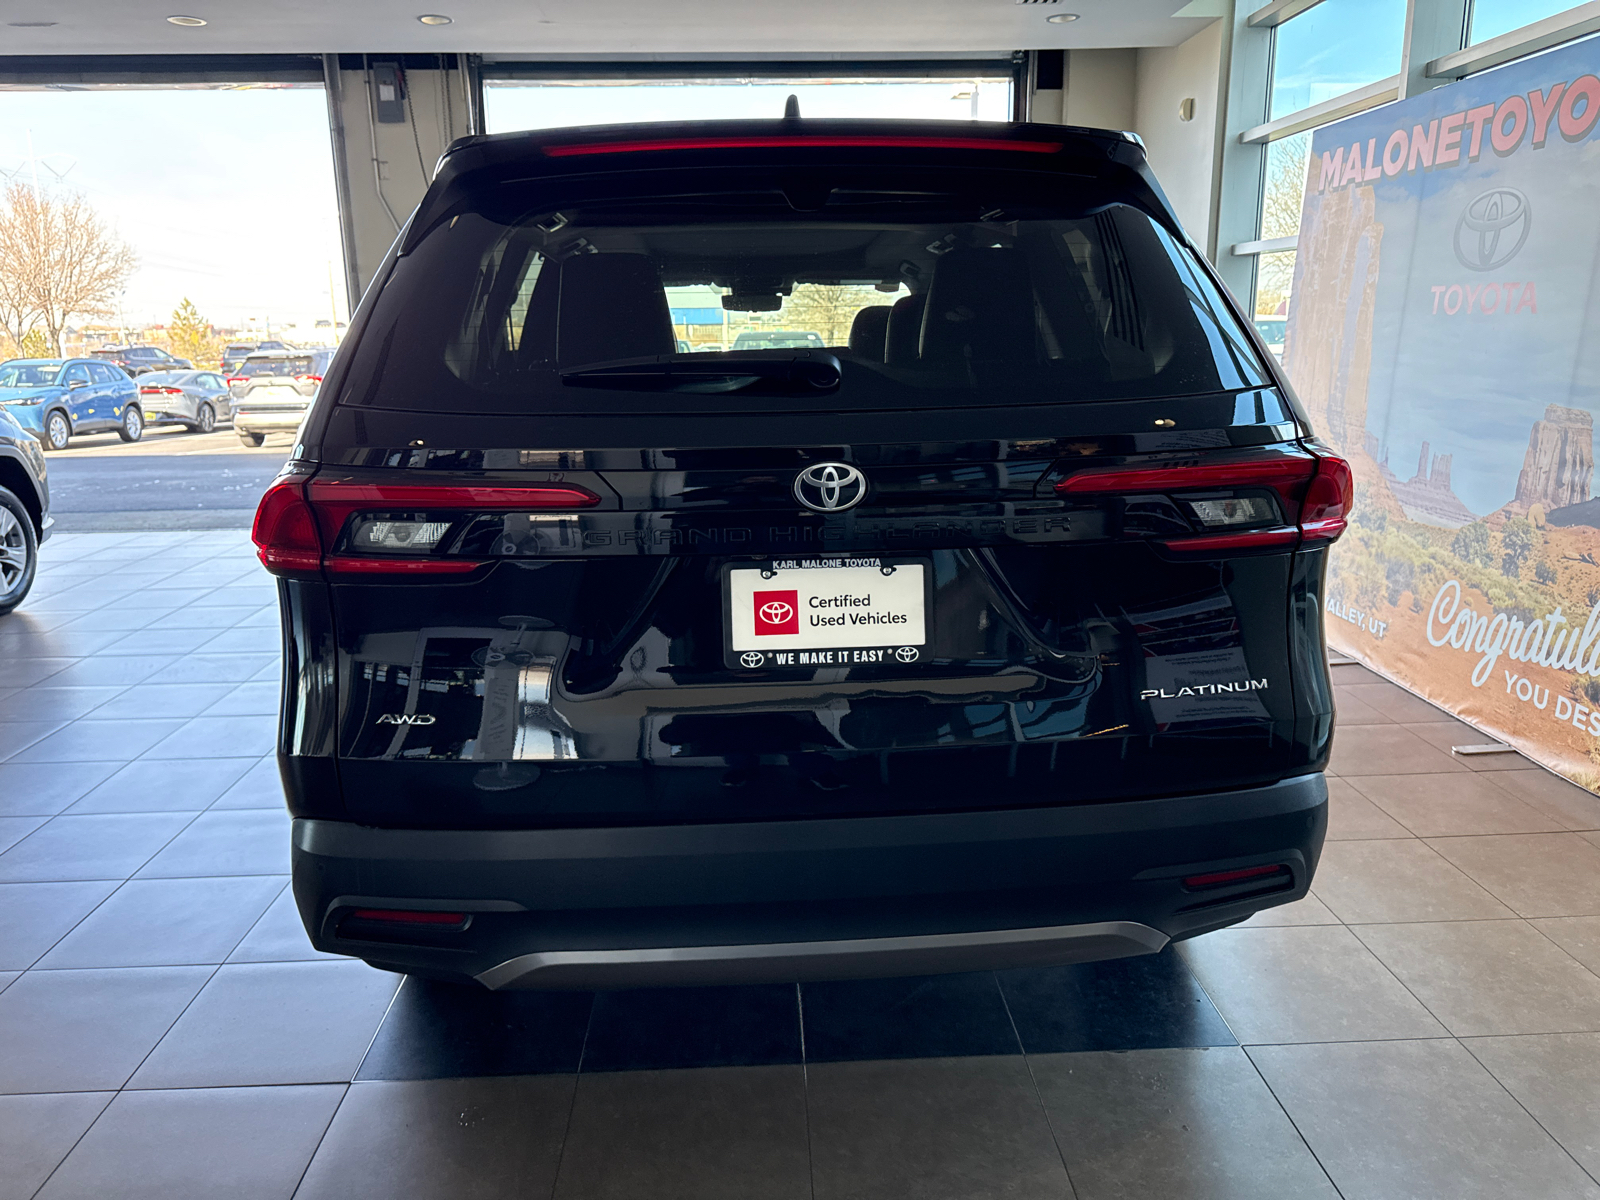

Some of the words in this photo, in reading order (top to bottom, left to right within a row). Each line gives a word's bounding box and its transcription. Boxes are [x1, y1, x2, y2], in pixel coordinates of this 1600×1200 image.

[1430, 281, 1538, 315] TOYOTA
[583, 527, 751, 546] GRAND
[772, 560, 799, 570] KARL
[801, 559, 842, 569] MALONE
[844, 558, 882, 568] TOYOTA
[808, 594, 871, 608] Certified
[809, 613, 846, 626] Used
[849, 611, 907, 625] Vehicles
[1369, 617, 1387, 637] UT
[776, 653, 795, 665] WE
[800, 652, 834, 664] MAKE
[838, 651, 849, 663] IT
[853, 650, 884, 662] EASY
[1140, 678, 1269, 700] PLATINUM
[1504, 670, 1549, 710] YOU
[1555, 695, 1600, 737] DES
[376, 714, 436, 725] AWD
